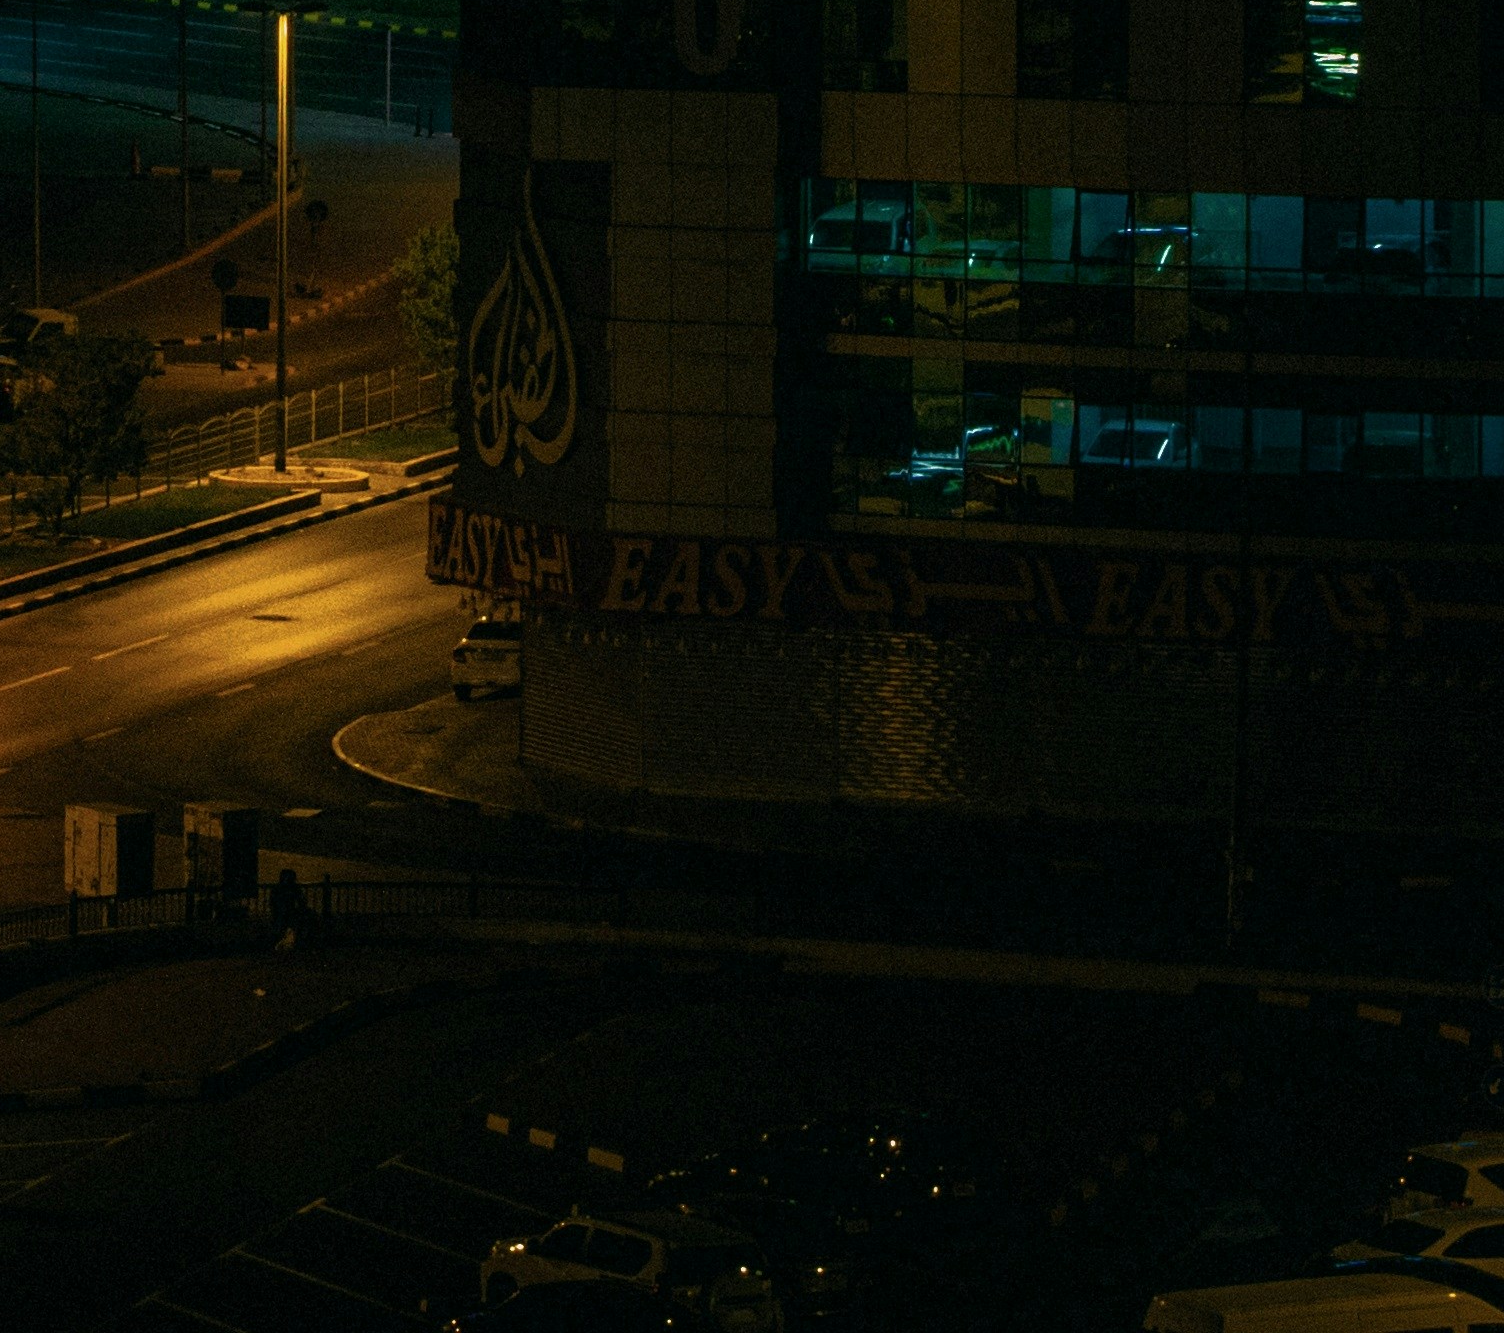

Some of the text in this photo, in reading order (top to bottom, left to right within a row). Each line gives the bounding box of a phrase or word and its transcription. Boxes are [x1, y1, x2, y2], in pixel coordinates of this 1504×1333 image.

[426, 503, 502, 589] EASY
[597, 536, 807, 620] EASY
[1085, 559, 1295, 642] EASY
